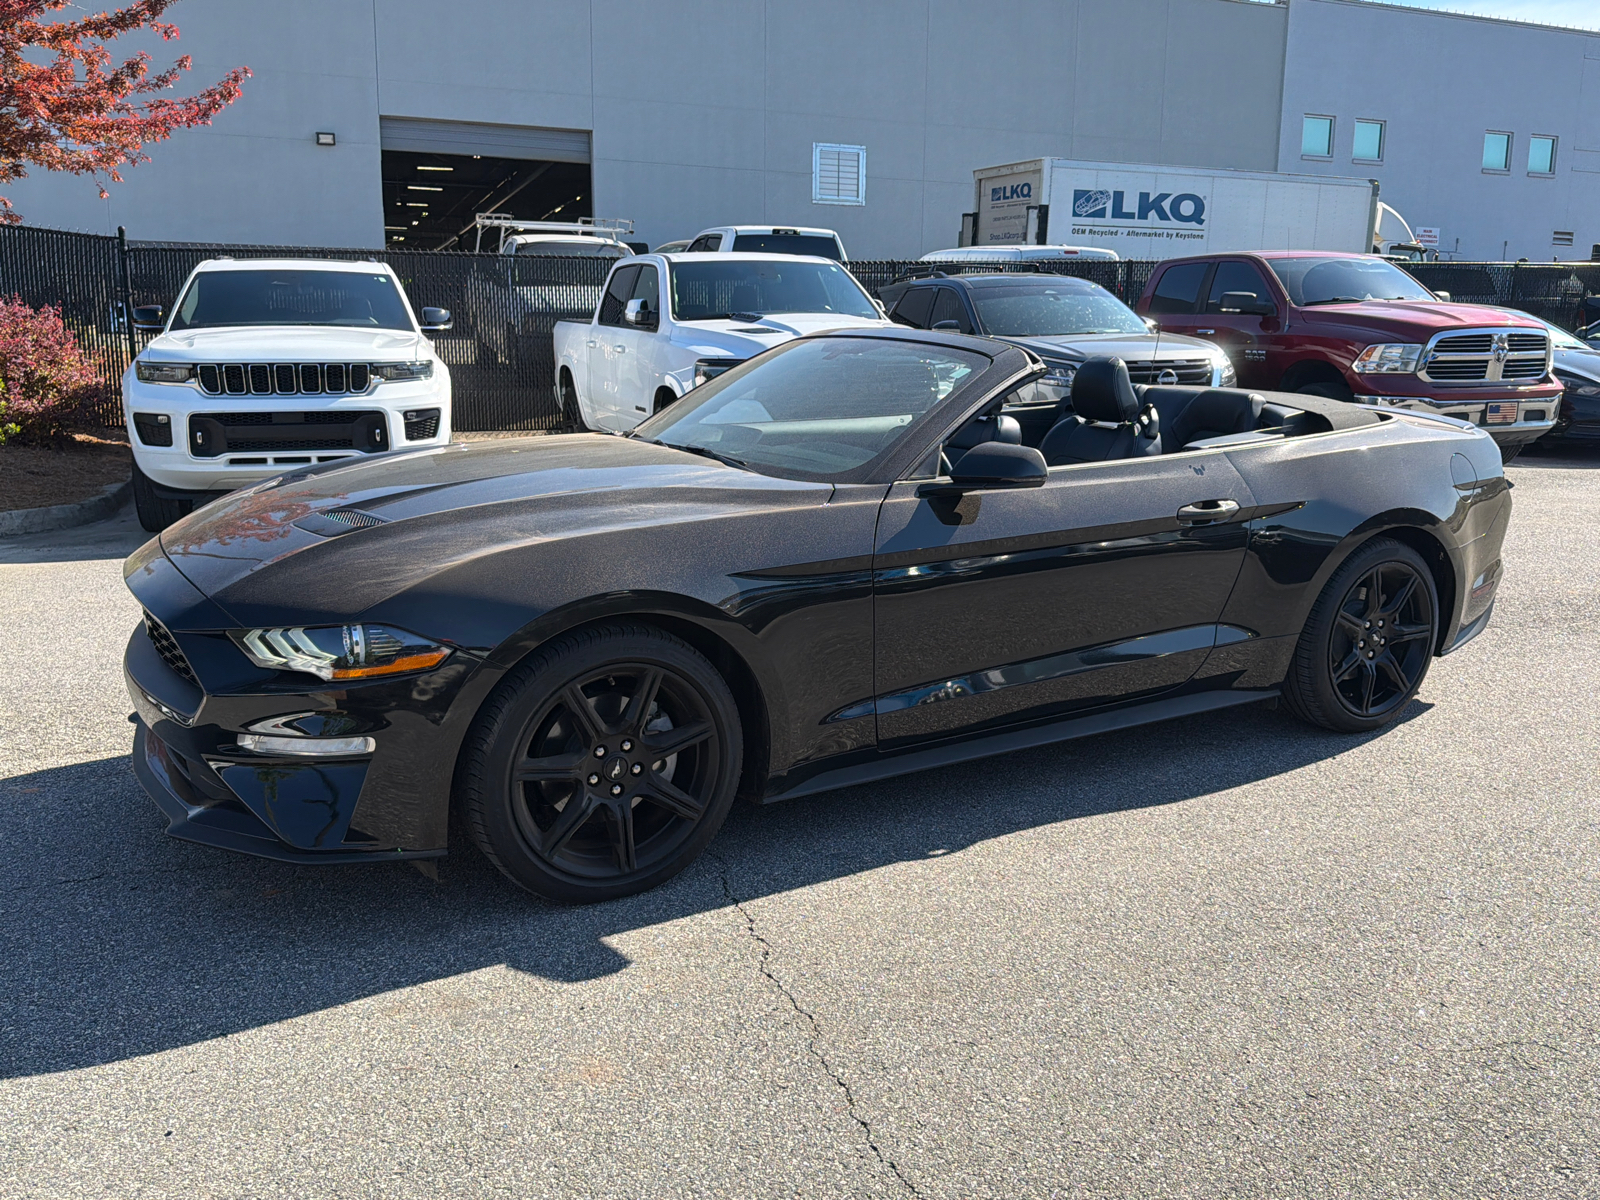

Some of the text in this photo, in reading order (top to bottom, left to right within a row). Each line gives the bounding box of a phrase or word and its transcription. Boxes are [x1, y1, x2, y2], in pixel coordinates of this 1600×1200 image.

[1002, 182, 1032, 200] LKQ
[1111, 190, 1206, 226] LKQ
[1088, 229, 1119, 237] Recycled
[1126, 230, 1165, 238] Aftermarket
[1166, 231, 1174, 240] by
[1175, 232, 1204, 241] Keystone
